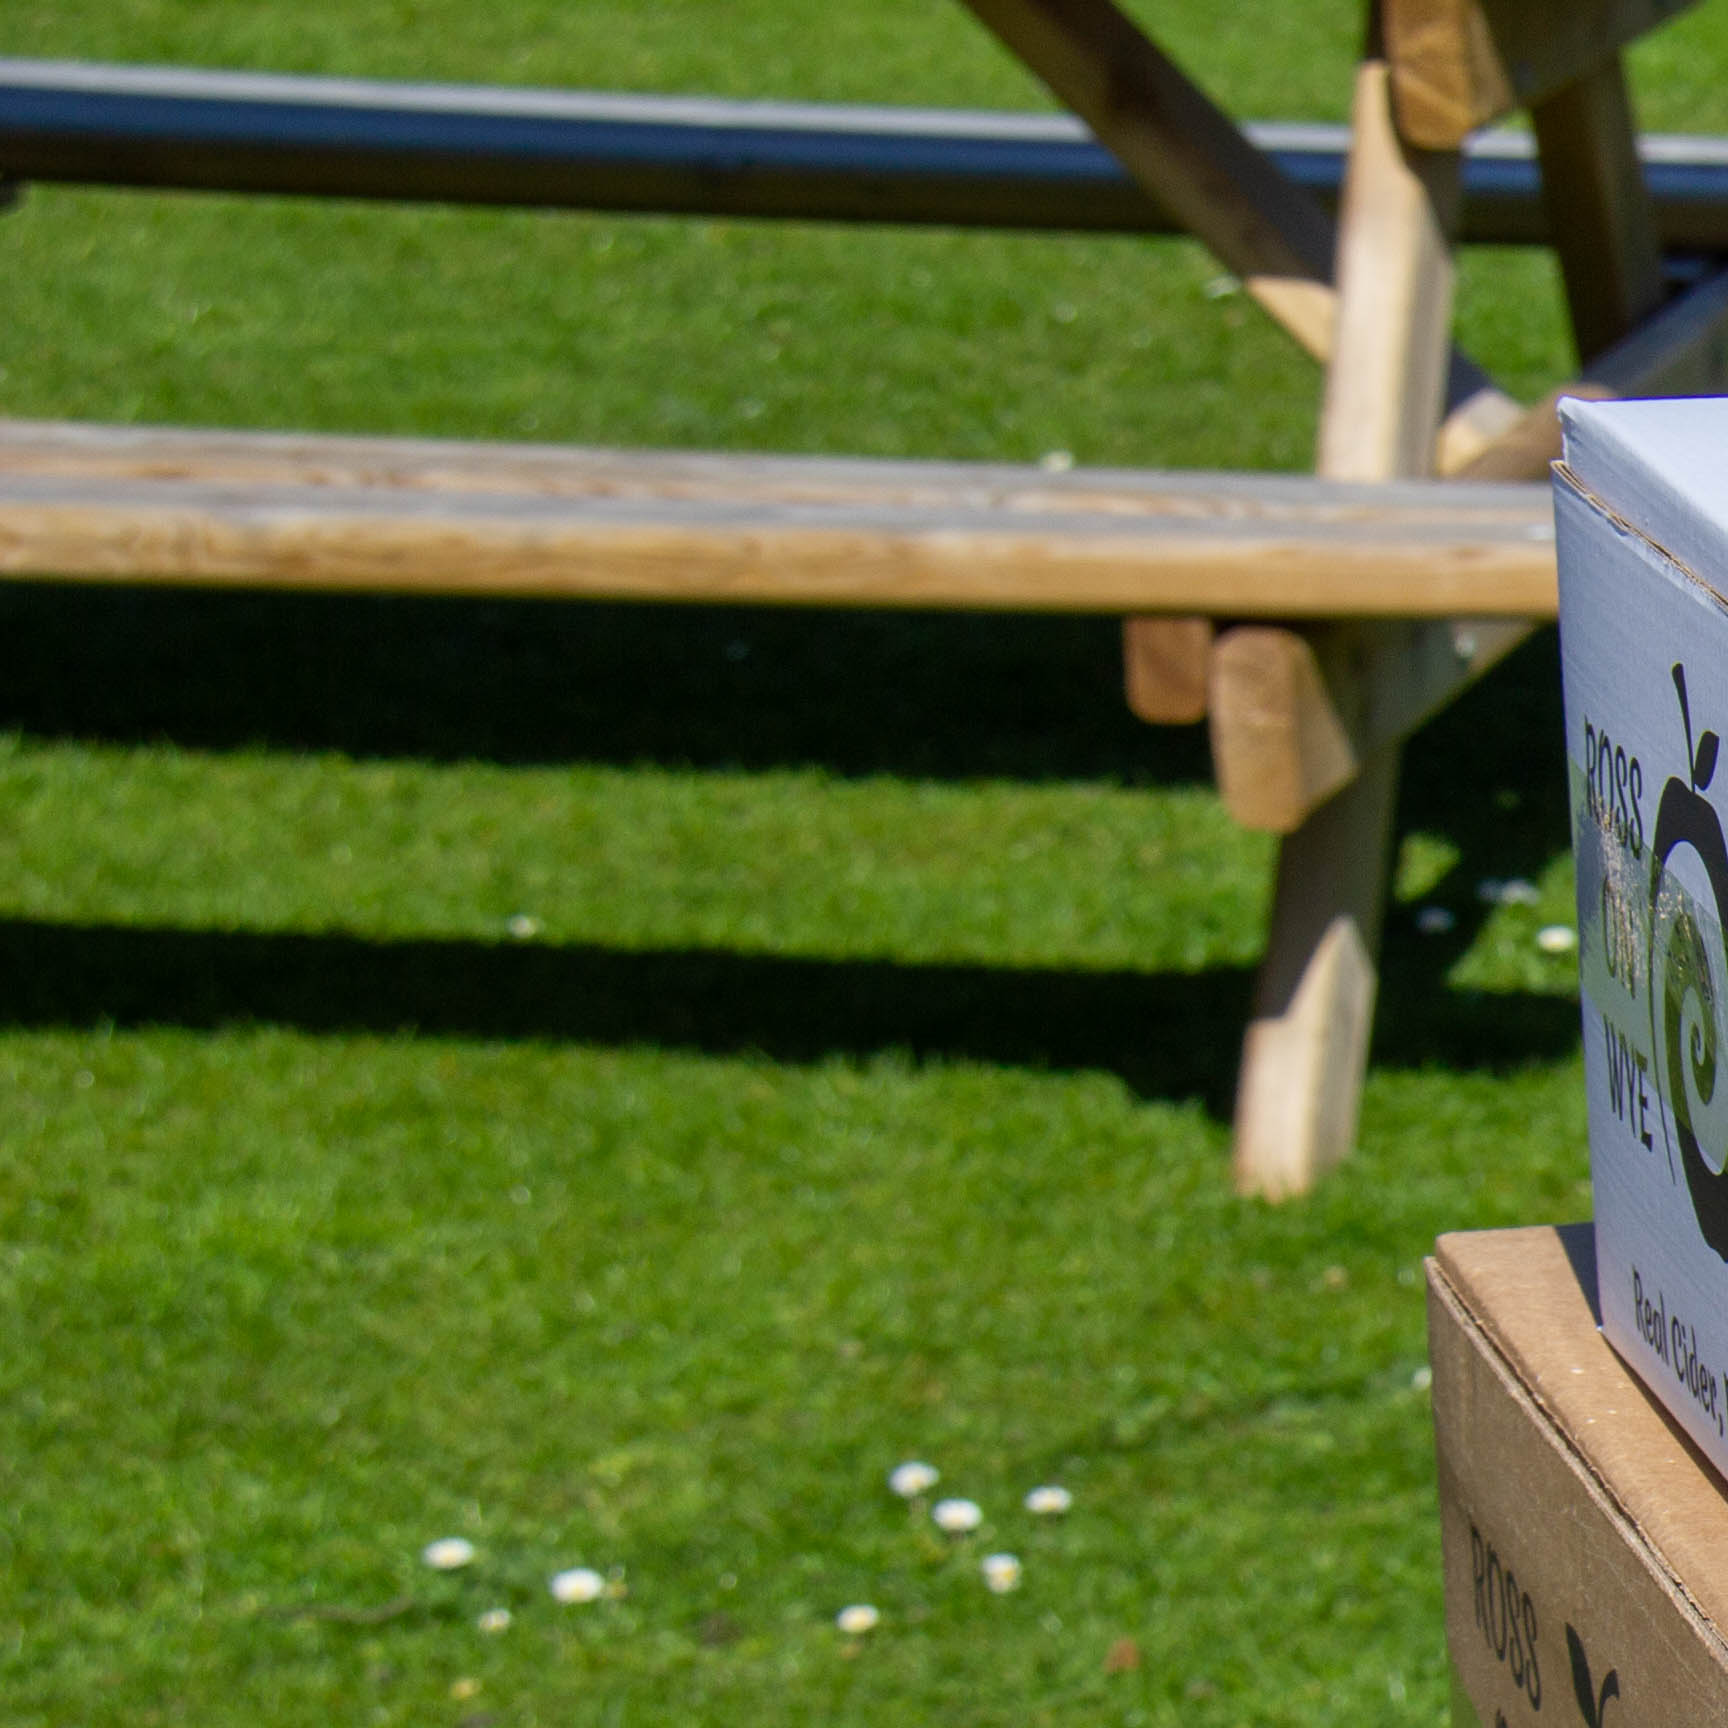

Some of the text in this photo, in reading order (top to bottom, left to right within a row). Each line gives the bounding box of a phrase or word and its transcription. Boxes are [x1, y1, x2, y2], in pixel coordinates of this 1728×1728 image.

[1584, 714, 1643, 860] ROSS
[1603, 1013, 1653, 1152] WYE
[1632, 1263, 1669, 1367] Real
[1671, 1314, 1724, 1438] Cider,
[1470, 1524, 1540, 1712] ROSS
